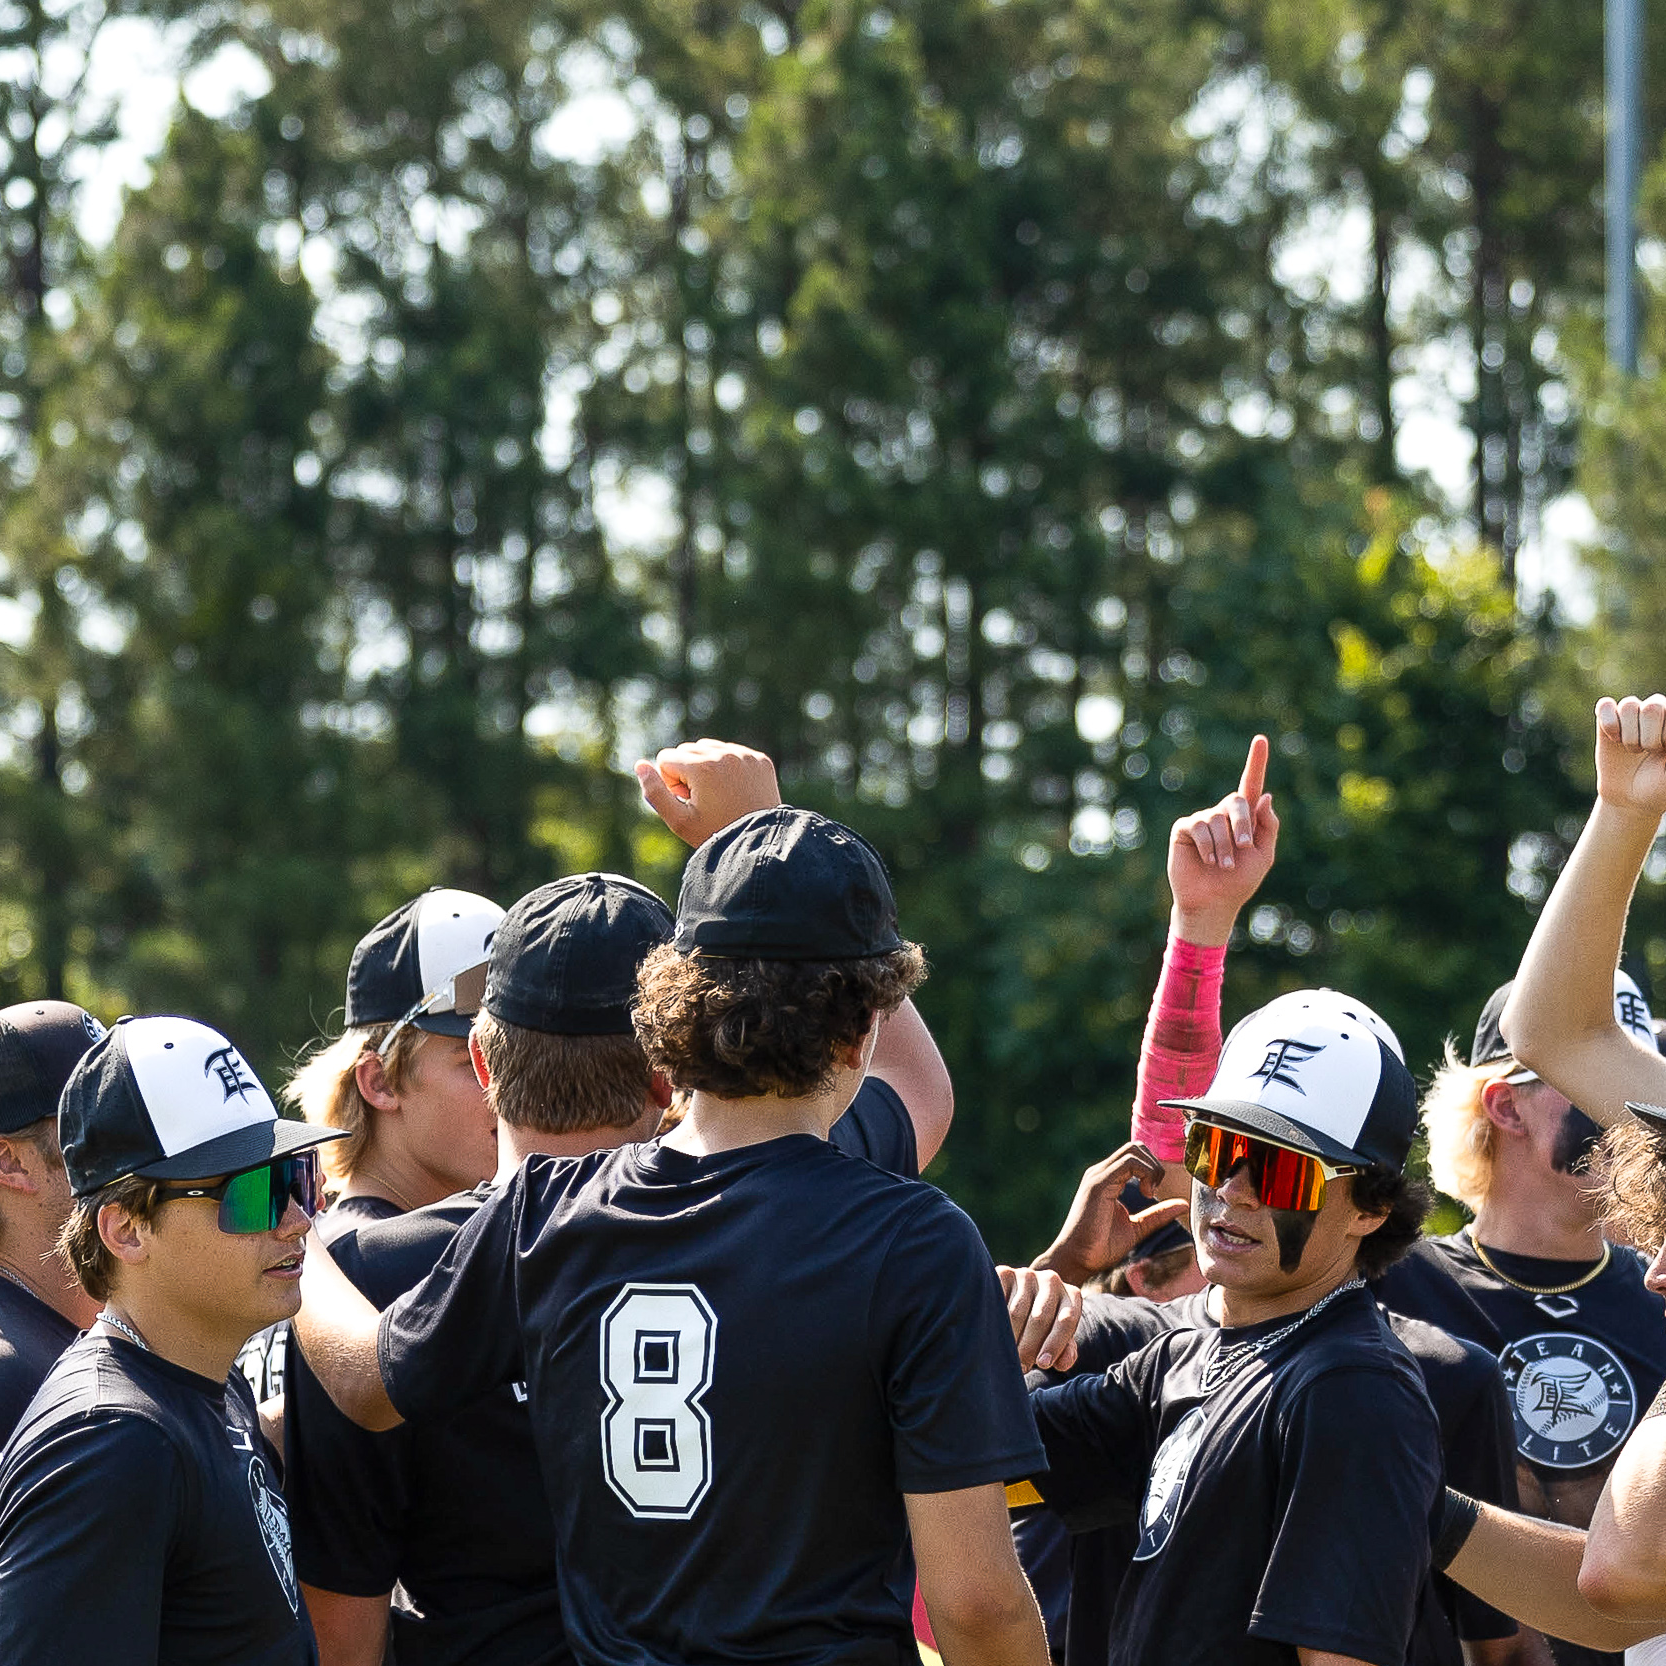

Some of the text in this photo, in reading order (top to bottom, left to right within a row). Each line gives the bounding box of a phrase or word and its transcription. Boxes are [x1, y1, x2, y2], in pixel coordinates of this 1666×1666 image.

[1510, 1341, 1616, 1379] TEAM
[599, 1282, 719, 1520] 8
[1512, 1412, 1621, 1462] LITE
